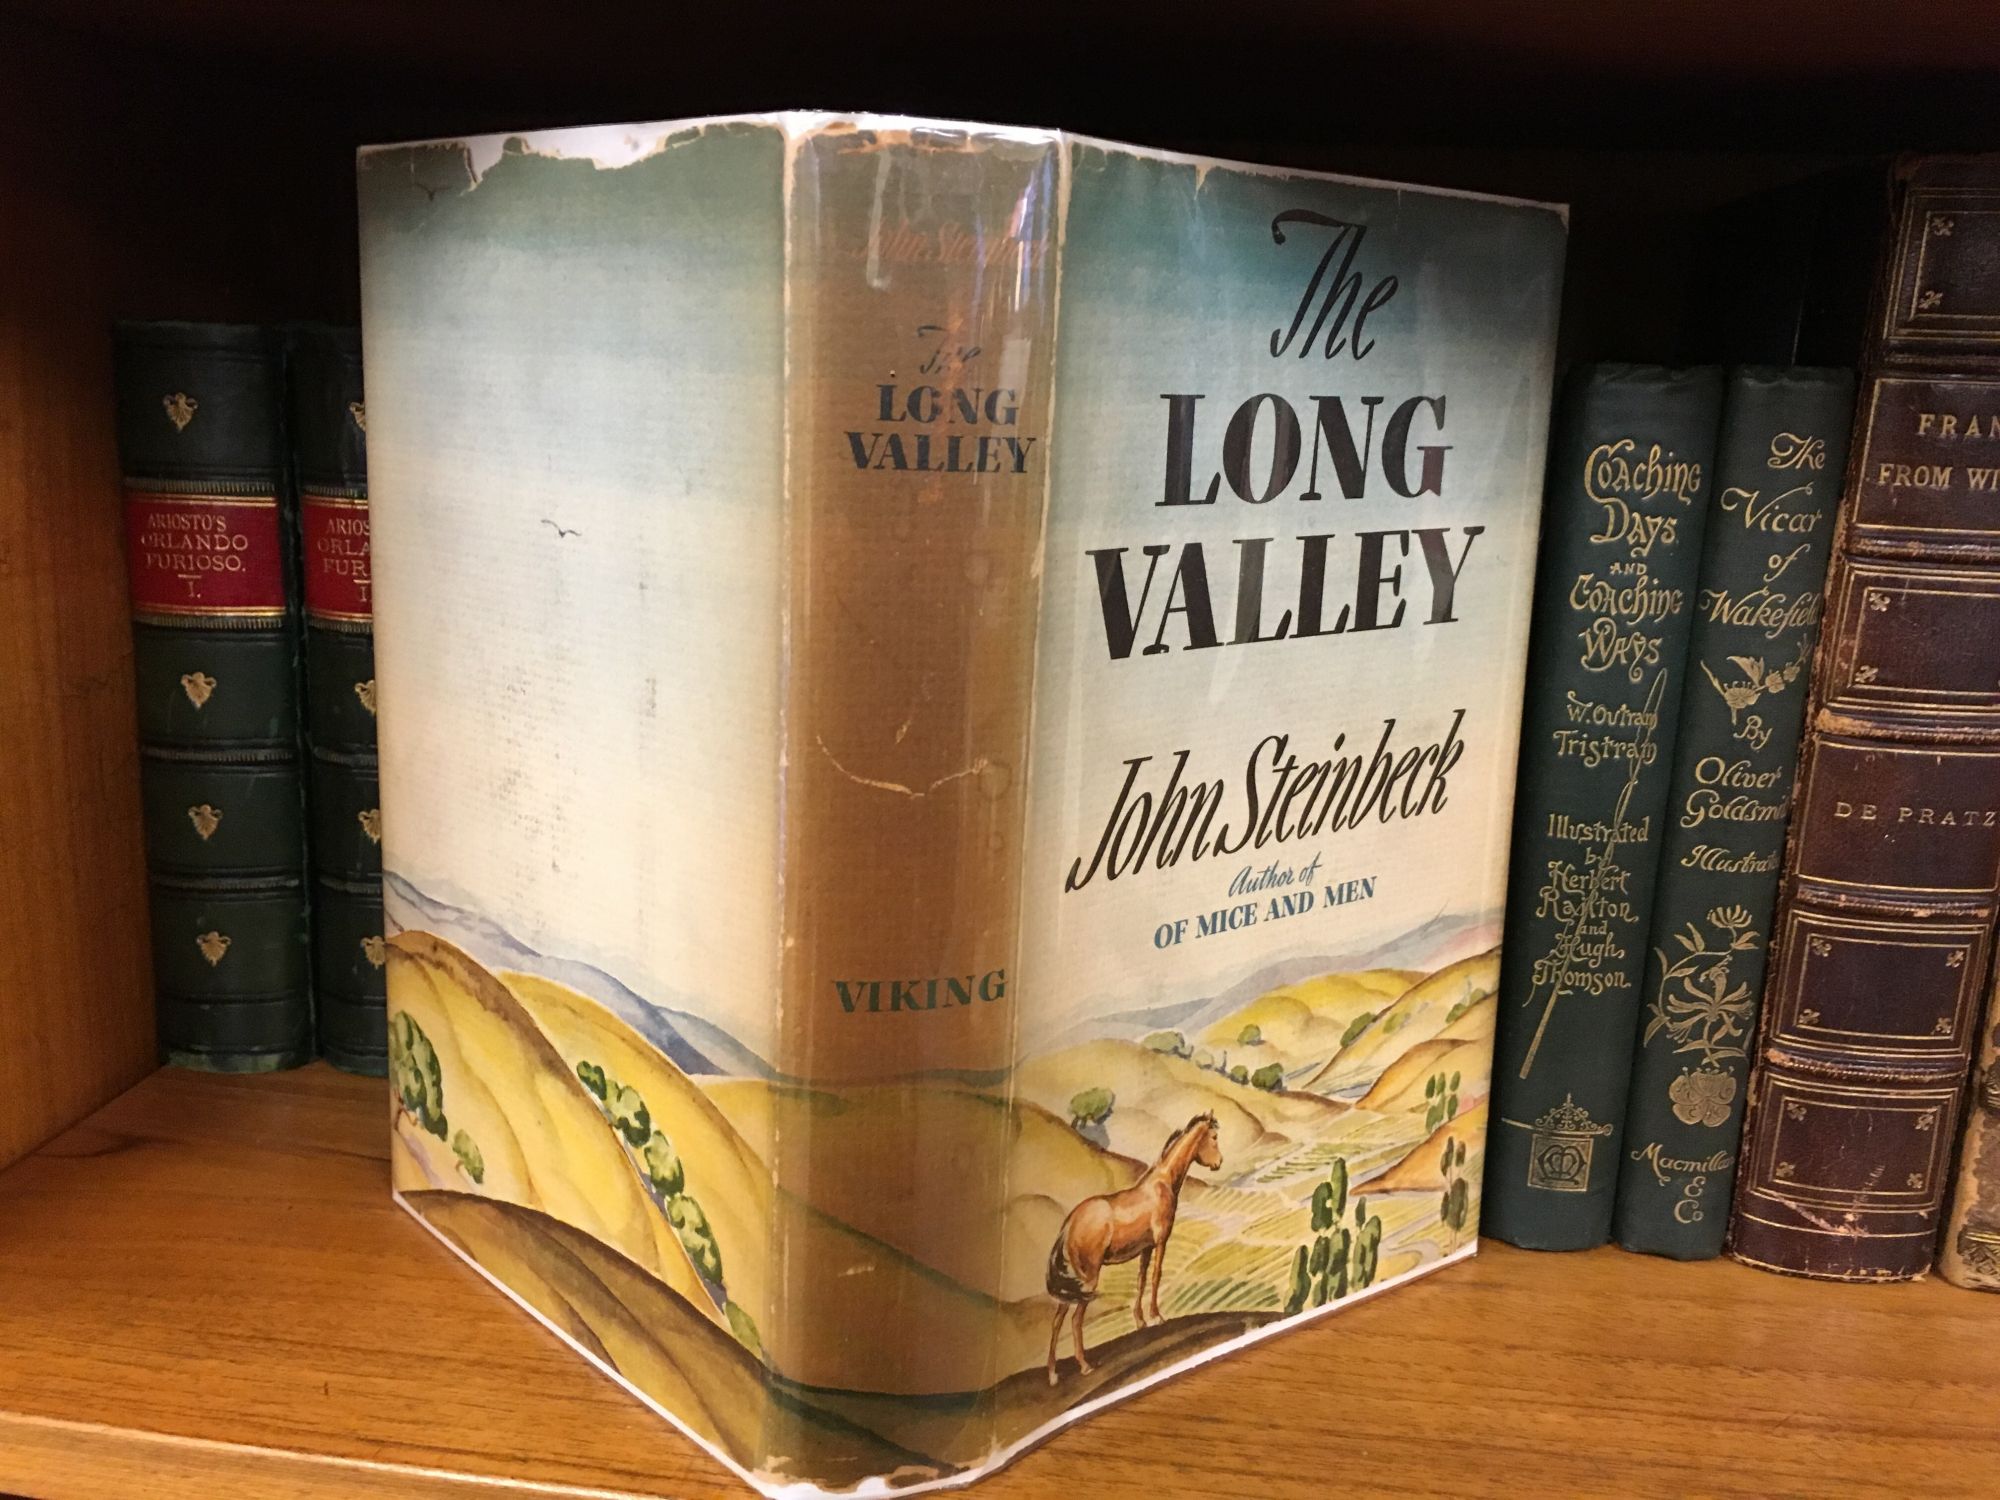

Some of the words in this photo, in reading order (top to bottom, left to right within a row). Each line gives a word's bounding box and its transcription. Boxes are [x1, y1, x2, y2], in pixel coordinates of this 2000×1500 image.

[1270, 208, 1399, 360] The
[916, 324, 981, 374] Te
[876, 384, 1019, 426] LONG
[843, 430, 1037, 474] VALLEY
[1155, 393, 1453, 506] LONG
[1767, 432, 1825, 470] The
[1878, 463, 1953, 490] FROM
[1721, 482, 1822, 533] Vicar
[1609, 561, 1648, 576] AND
[1764, 544, 1811, 582] of
[1085, 526, 1485, 660] VALLEY
[1593, 704, 1658, 730] Outram
[1734, 715, 1773, 751] By
[1553, 730, 1657, 767] Tristram
[1695, 757, 1782, 788] Oliver
[1065, 749, 1224, 893] John
[1212, 709, 1466, 858] Steinbeck
[1680, 789, 1790, 828] Goldsmi
[1834, 801, 1877, 820] DE
[1898, 806, 1997, 827] PRATZ
[1547, 813, 1650, 844] Illustrated
[1228, 860, 1294, 898] Author
[1298, 852, 1323, 884] of
[1681, 845, 1780, 872] Illustrat
[1548, 860, 1631, 896] Herbert
[1154, 920, 1188, 949] OF
[1195, 903, 1258, 939] MICE
[1263, 891, 1314, 921] AND
[1323, 876, 1378, 909] MEN
[1580, 920, 1608, 935] and
[832, 968, 1008, 1013] VIKING
